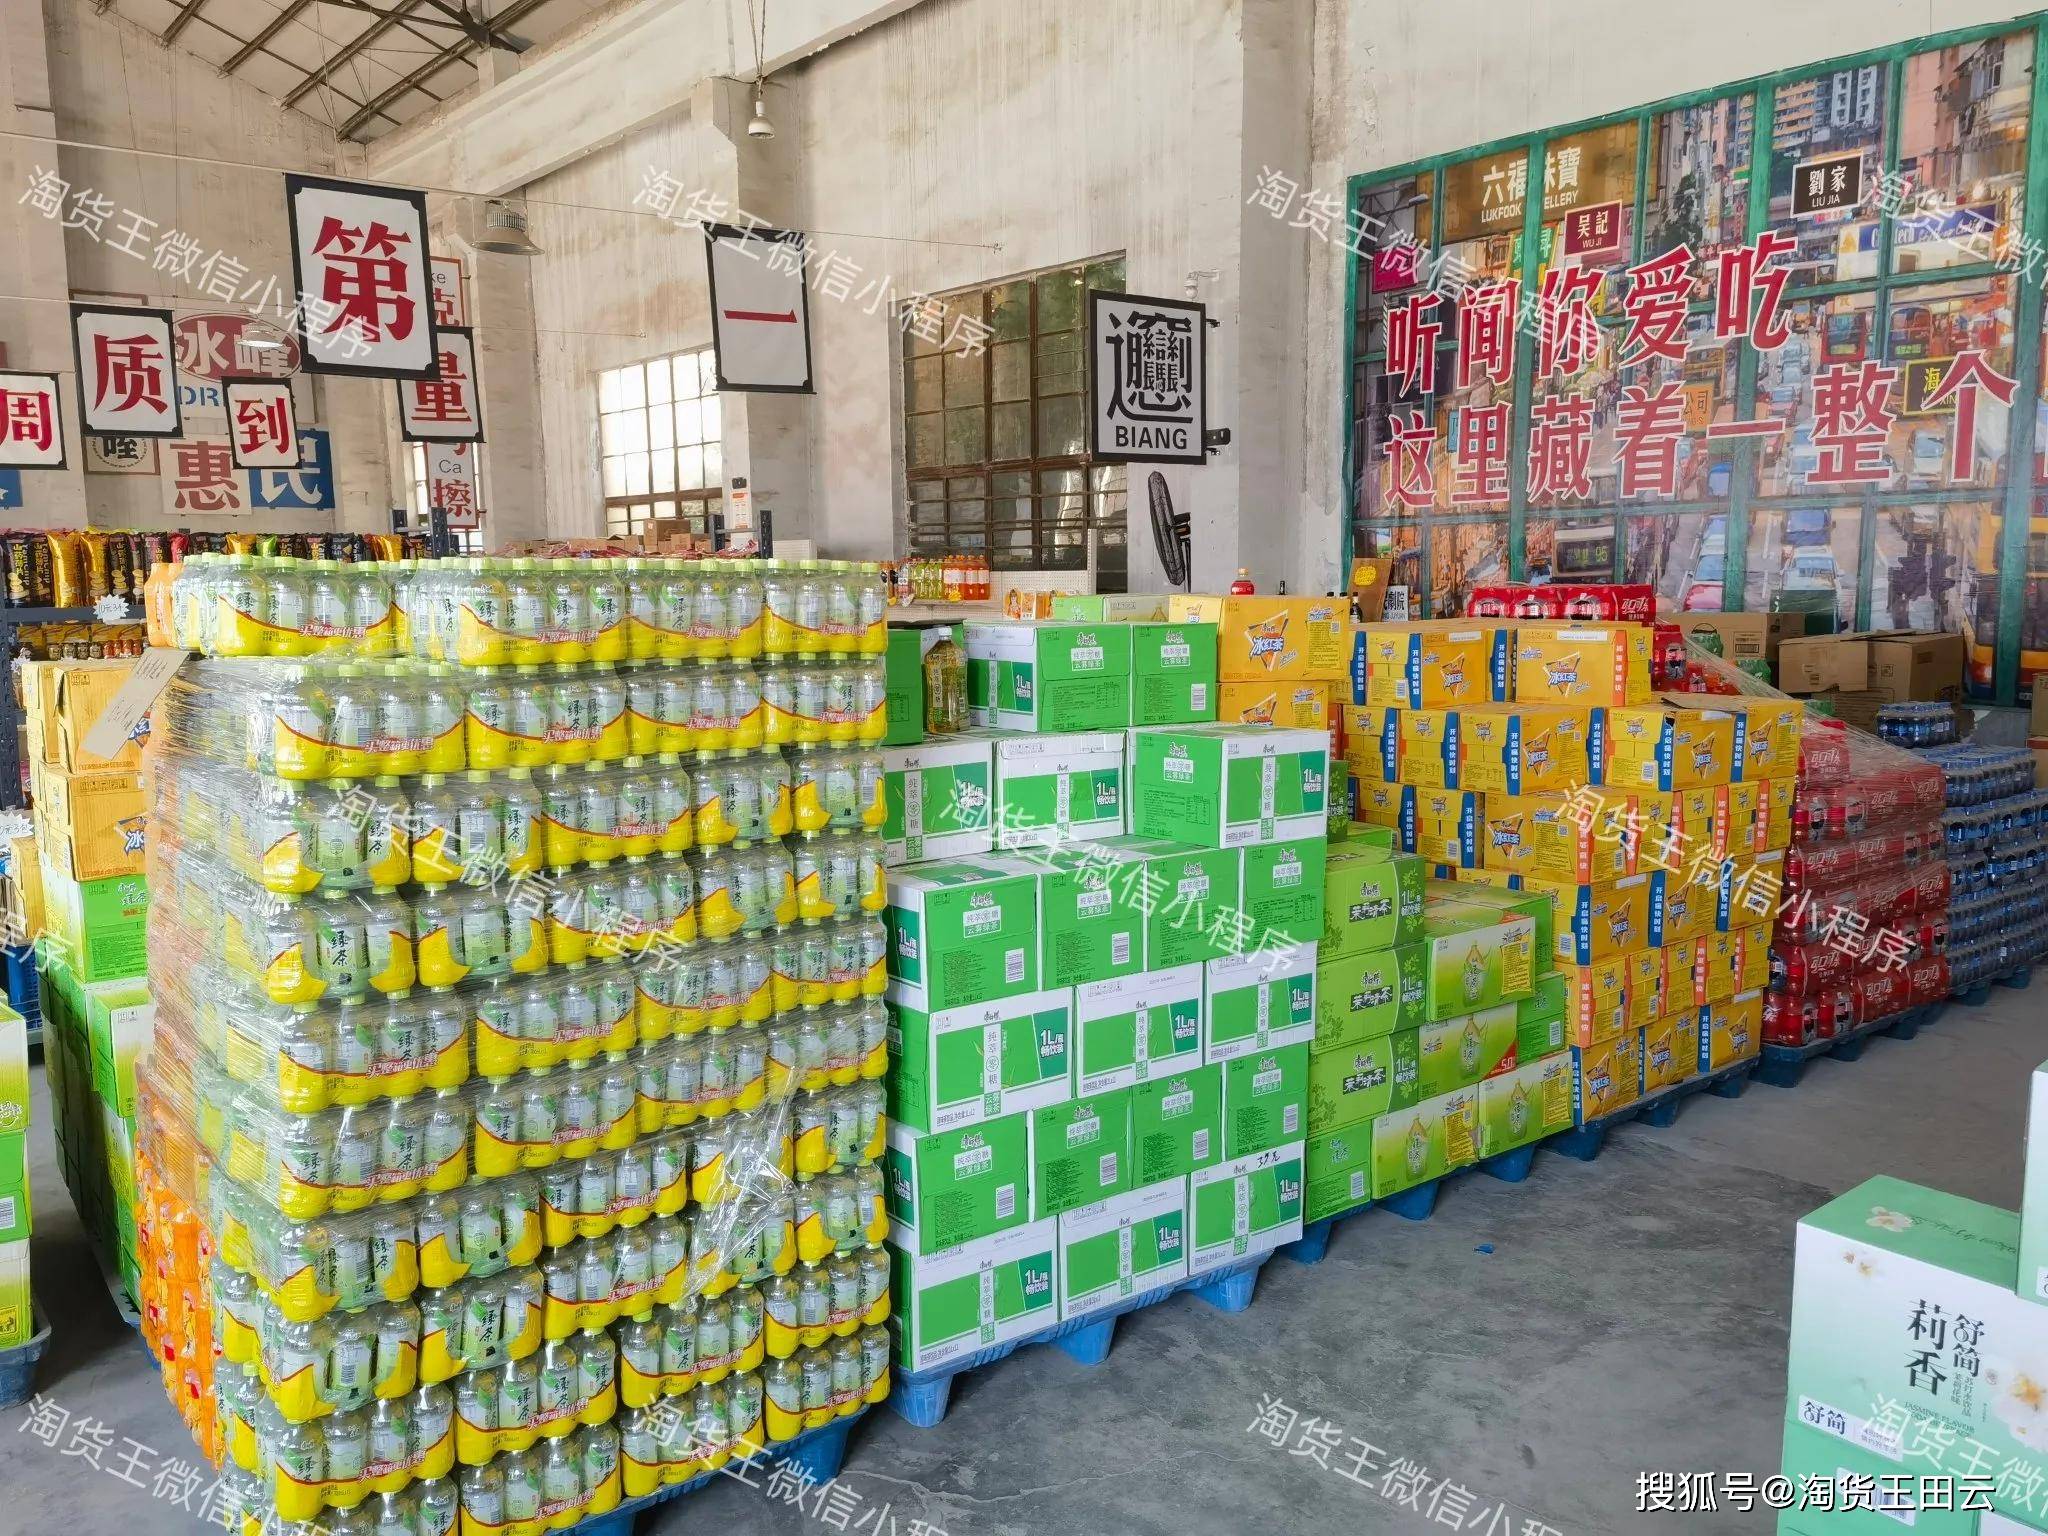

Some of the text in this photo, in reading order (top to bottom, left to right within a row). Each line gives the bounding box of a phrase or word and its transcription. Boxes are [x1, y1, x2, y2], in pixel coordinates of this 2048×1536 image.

[1808, 165, 1848, 196] 劉家
[1544, 191, 1579, 210] ELLERY
[1811, 194, 1840, 208] LIU JIA
[1583, 239, 1595, 248] WU
[312, 215, 416, 343] 第
[723, 308, 798, 324] 一
[1386, 230, 1799, 399] 听闻你爱吃
[93, 332, 169, 415] 质
[411, 350, 473, 423] 量
[0, 388, 53, 452] 周
[235, 396, 290, 455] 到
[1115, 425, 1188, 450] BIANG
[1383, 348, 2021, 509] 这里藏着一整个
[438, 459, 463, 474] Ca
[299, 624, 368, 640] 买整箱更优惠
[1904, 1298, 1951, 1397] 莉香
[1803, 1400, 1846, 1436] 舒简
